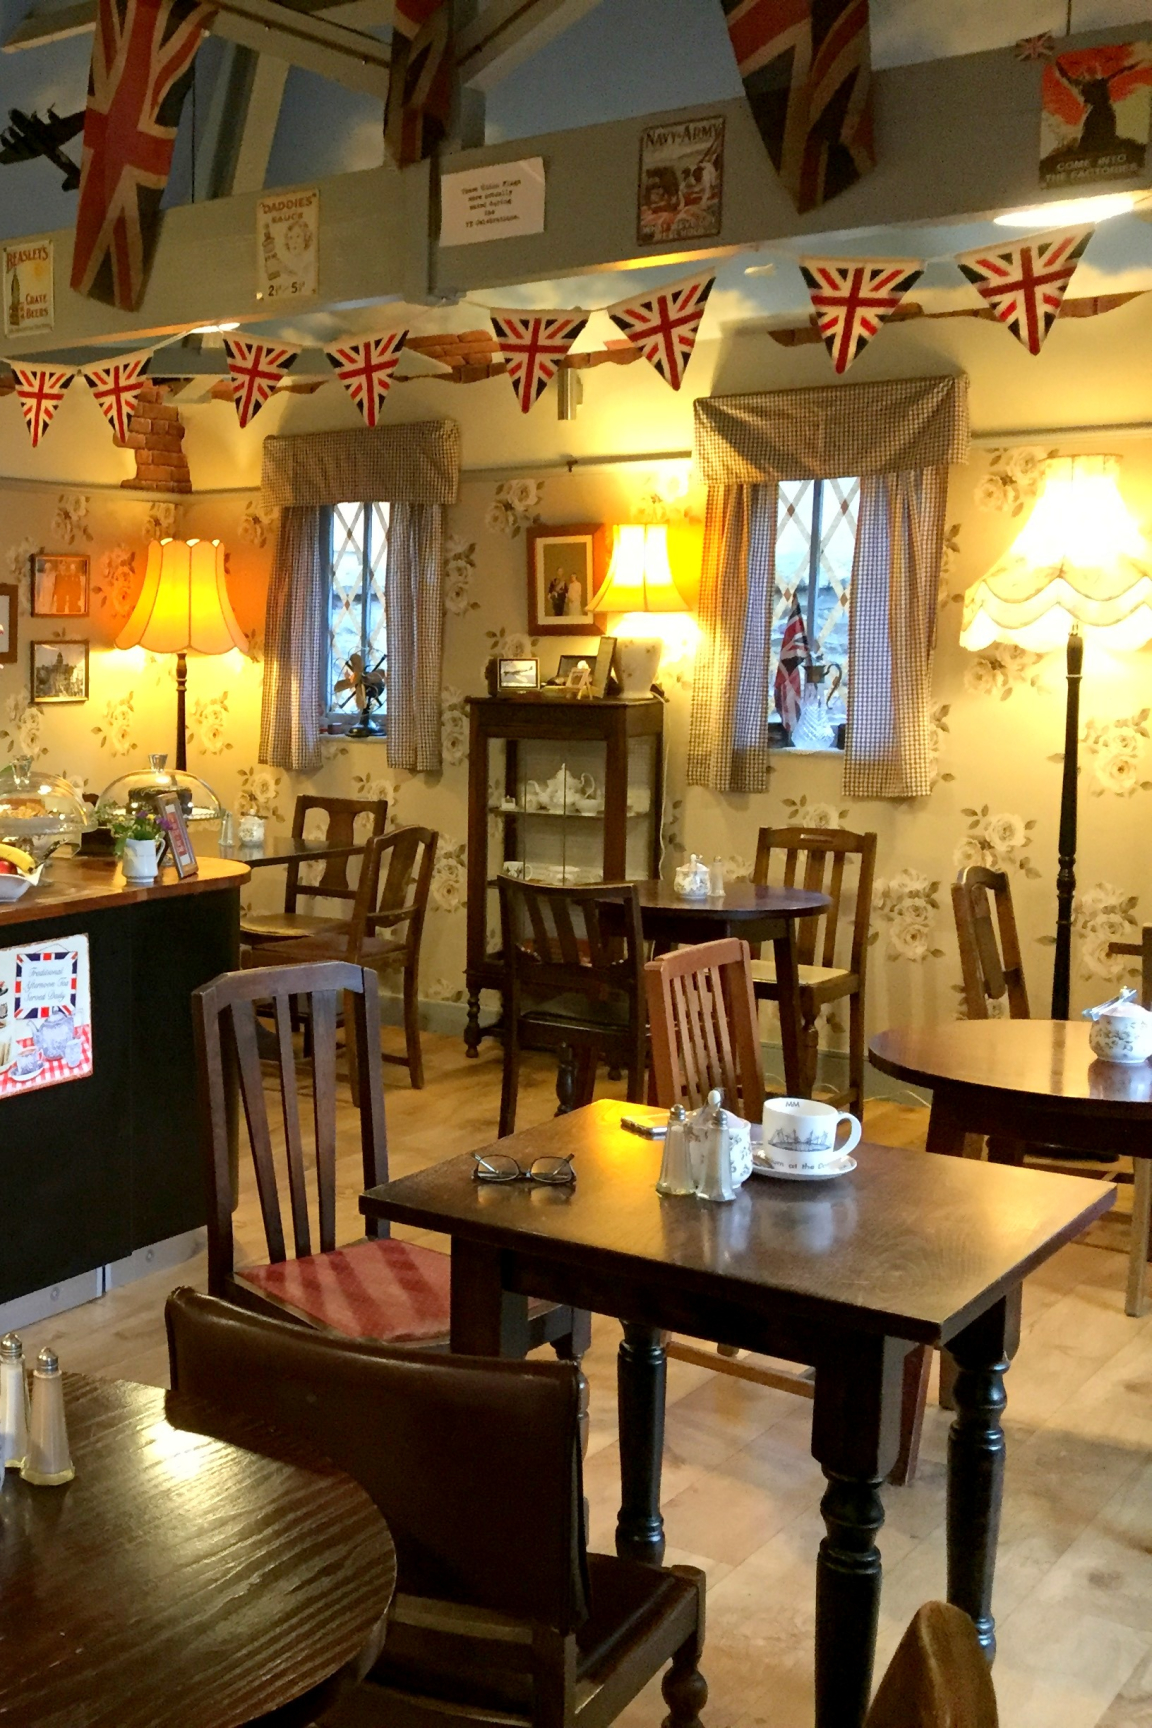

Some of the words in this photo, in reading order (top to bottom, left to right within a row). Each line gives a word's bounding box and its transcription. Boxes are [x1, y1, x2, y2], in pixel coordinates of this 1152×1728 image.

[646, 130, 677, 147] NAVY
[684, 121, 723, 141] ARMY
[1056, 160, 1091, 172] COME
[1097, 153, 1128, 166] INTO
[1070, 163, 1139, 180] FACTORIES
[271, 212, 304, 224] SAUCE
[26, 293, 48, 305] CRATE
[26, 307, 48, 319] BEERS
[29, 966, 64, 977] Traditional
[25, 980, 55, 992] Afternoon
[58, 976, 69, 987] Tea
[25, 991, 46, 1002] Served
[48, 990, 66, 1003] Daily
[801, 1162, 815, 1170] the
